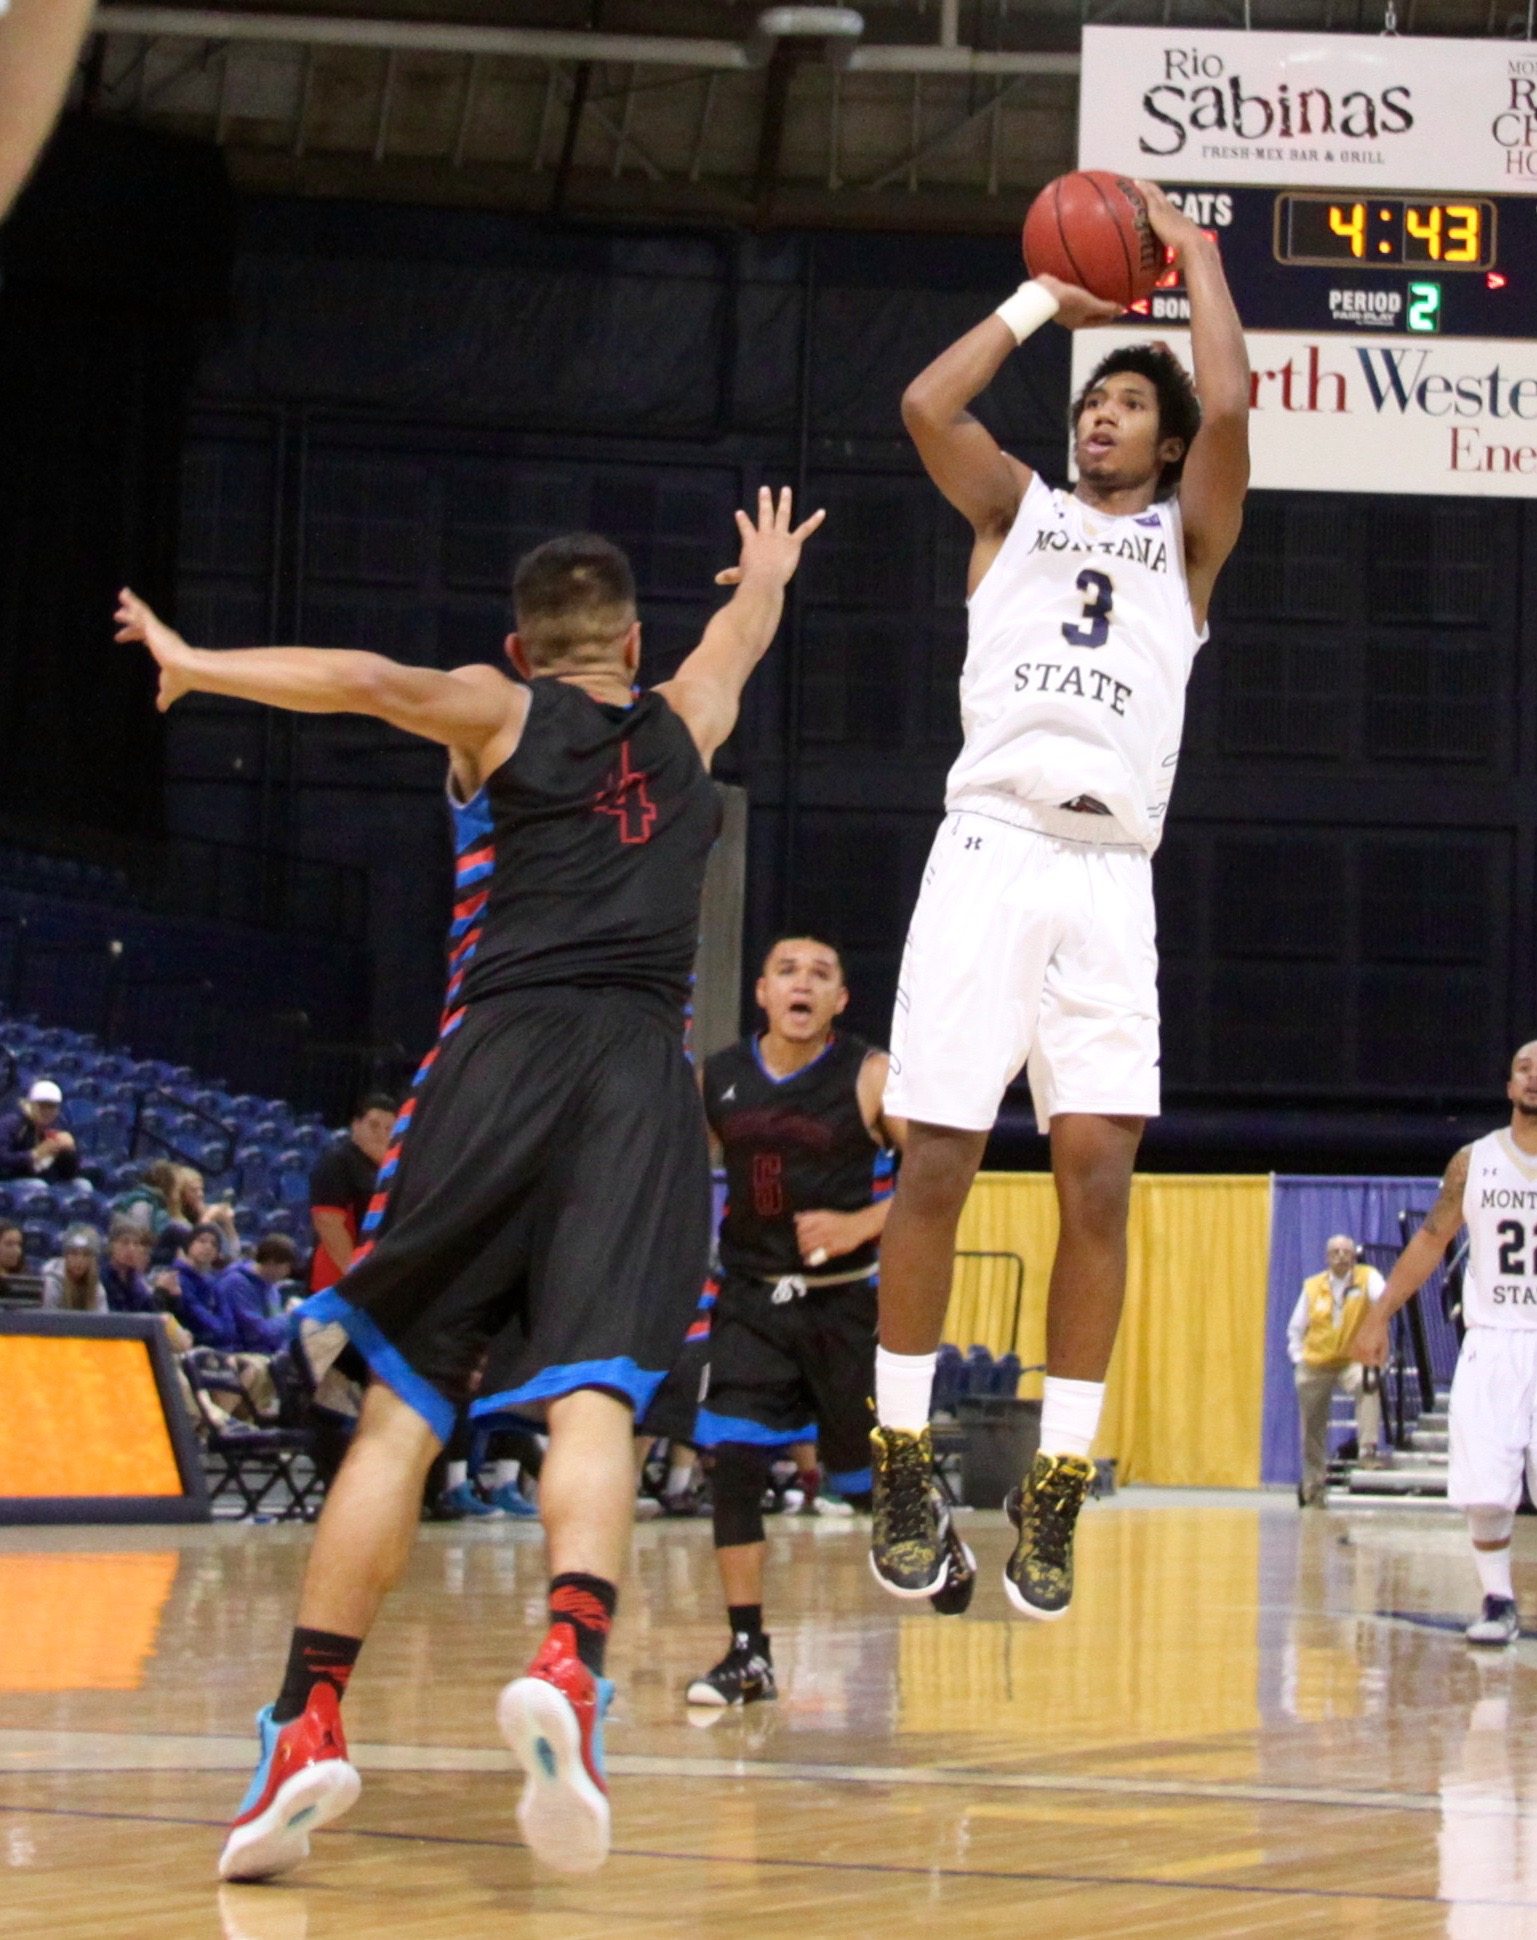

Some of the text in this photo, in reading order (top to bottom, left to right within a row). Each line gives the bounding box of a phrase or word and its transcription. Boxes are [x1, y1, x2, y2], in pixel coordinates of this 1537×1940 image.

[1163, 48, 1224, 80] Rio
[1138, 75, 1414, 156] Sabinas
[1290, 149, 1319, 162] BAR
[1340, 151, 1387, 164] GRILL
[1328, 203, 1481, 262] 4:43
[1329, 290, 1402, 313] PERIOD
[1409, 282, 1439, 331] 2
[1449, 426, 1537, 473] Ene
[1062, 568, 1114, 649] 3
[1014, 663, 1133, 716] STATE
[593, 739, 657, 844] 4
[1497, 1220, 1537, 1275] 2
